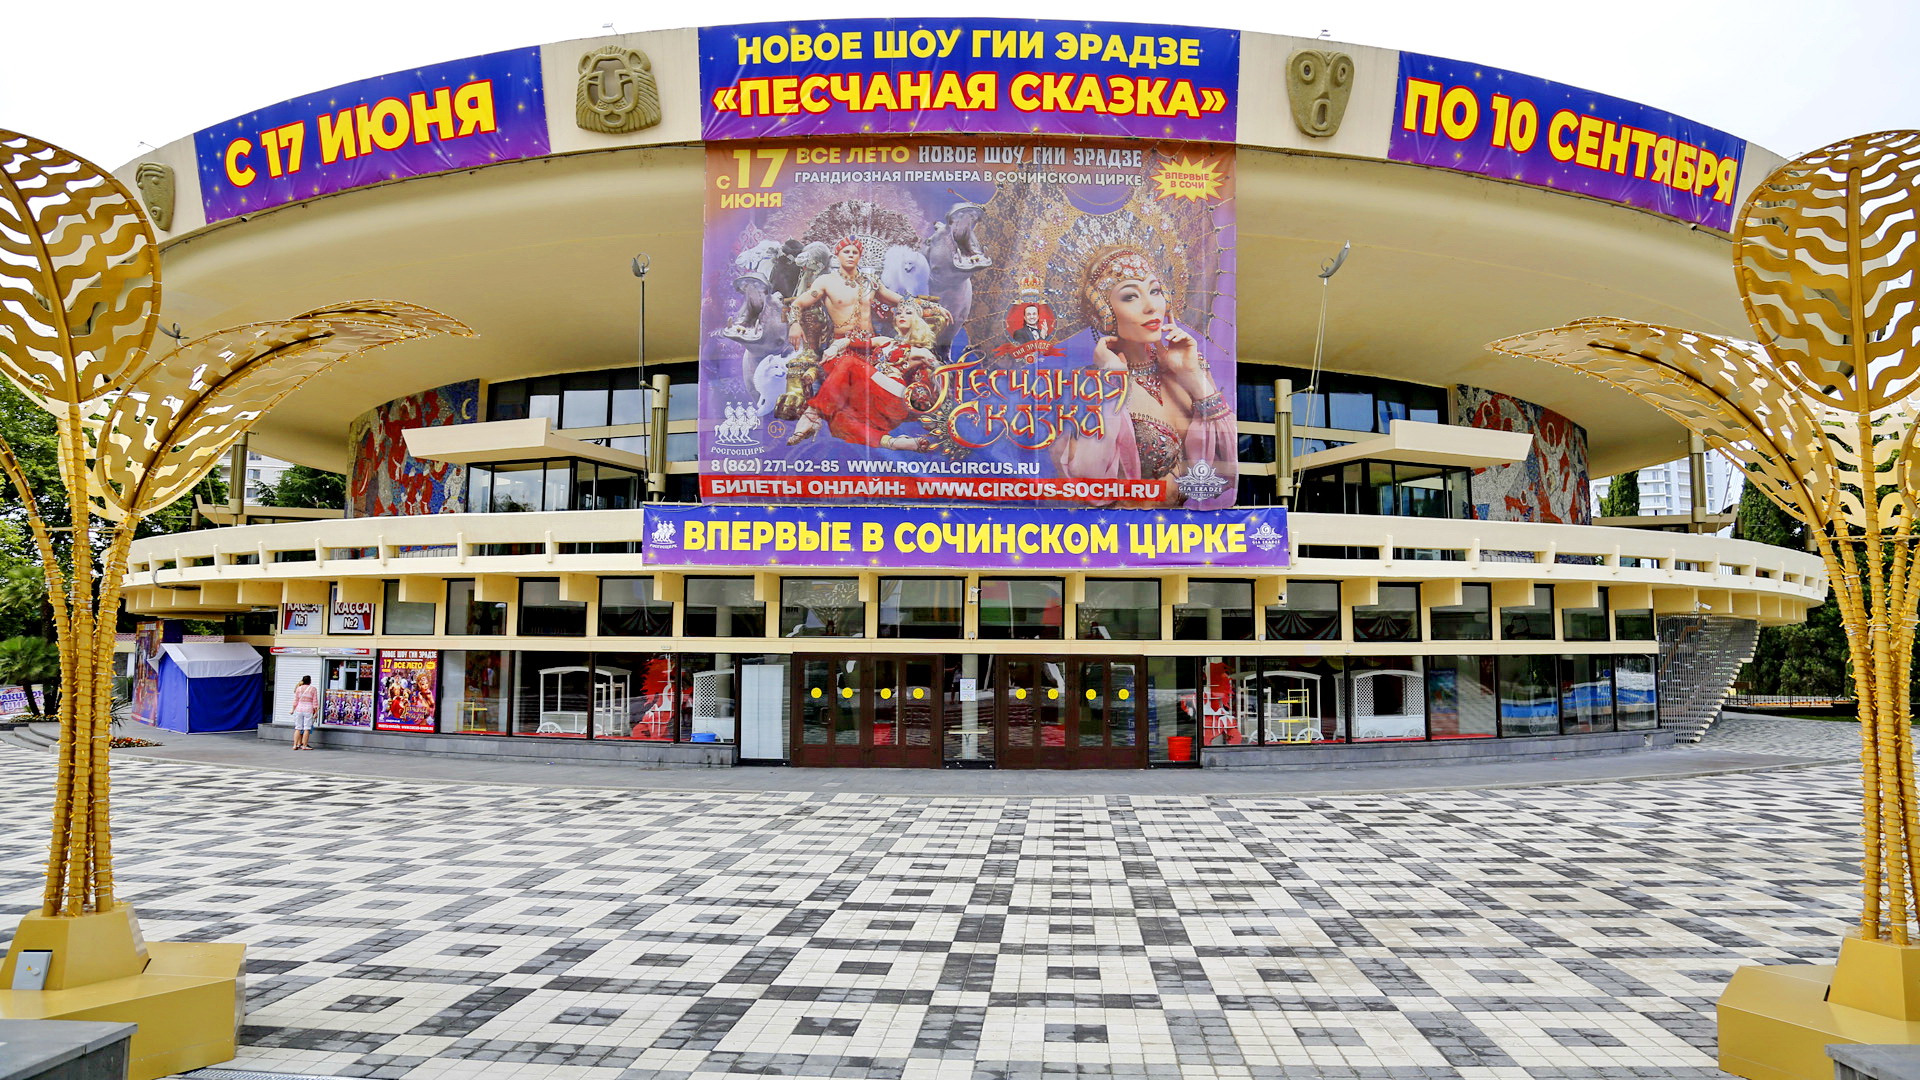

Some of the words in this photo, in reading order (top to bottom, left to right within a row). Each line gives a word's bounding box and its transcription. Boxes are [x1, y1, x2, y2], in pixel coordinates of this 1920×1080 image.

[738, 32, 863, 65] НОВОЕ
[874, 29, 961, 58] ШОУ
[972, 29, 1044, 59] ГИИ
[1054, 31, 1200, 69] ЭРАДЗЕ
[712, 70, 998, 117] «ПЕСЧАНАЯ
[1009, 72, 1229, 119] СКАЗКА»
[225, 137, 257, 188] С
[260, 120, 304, 178] 17
[317, 79, 496, 165] ИЮНЯ
[1403, 77, 1479, 141] ПО
[1491, 93, 1539, 153] 10
[1548, 109, 1739, 205] СЕНТЯБРЯ
[796, 148, 841, 164] ВСЕ
[846, 146, 911, 163] ЛЕТО
[918, 146, 977, 164] НОВОЕ
[984, 146, 1025, 164] ШОУ
[1032, 147, 1066, 165] ГИИ
[1073, 148, 1143, 169] ЭРАДЗЕ
[733, 149, 789, 189] 17
[1165, 172, 1210, 181] ВПЕРВЫЕ
[794, 171, 901, 184] ГРАНДИОЗНАЯ
[904, 170, 981, 183] ПРЕМЬЕРА
[984, 171, 993, 182] В
[995, 171, 1092, 185] СОЧИНСКОМ
[1095, 174, 1143, 186] ЦИРКЕ
[1179, 181, 1205, 189] СОЧИ
[720, 192, 783, 209] ИЮНЯ
[1025, 342, 1051, 352] ЭРАДЗЕ
[769, 424, 784, 434] 0+
[711, 446, 766, 457] РОСГОСЦИРК
[711, 459, 720, 472] 8
[723, 457, 761, 474] (862)
[763, 460, 840, 473] 271-02-85
[847, 460, 1040, 475] WWW.ROYALCIRCUS.RU
[711, 479, 802, 495] БИЛЕТЫ
[807, 477, 905, 495] ОНЛАЙН:
[916, 481, 1160, 498] WWW.CIRCUS-SOCHI.RU
[683, 520, 852, 552] ВПЕРВЫЕ
[862, 522, 885, 552] В
[894, 522, 1118, 554] СОЧИНСКОМ
[1130, 523, 1247, 558] ЦИРКЕ
[334, 601, 370, 614] КАССА
[295, 614, 308, 625] №1
[344, 617, 359, 628] №2
